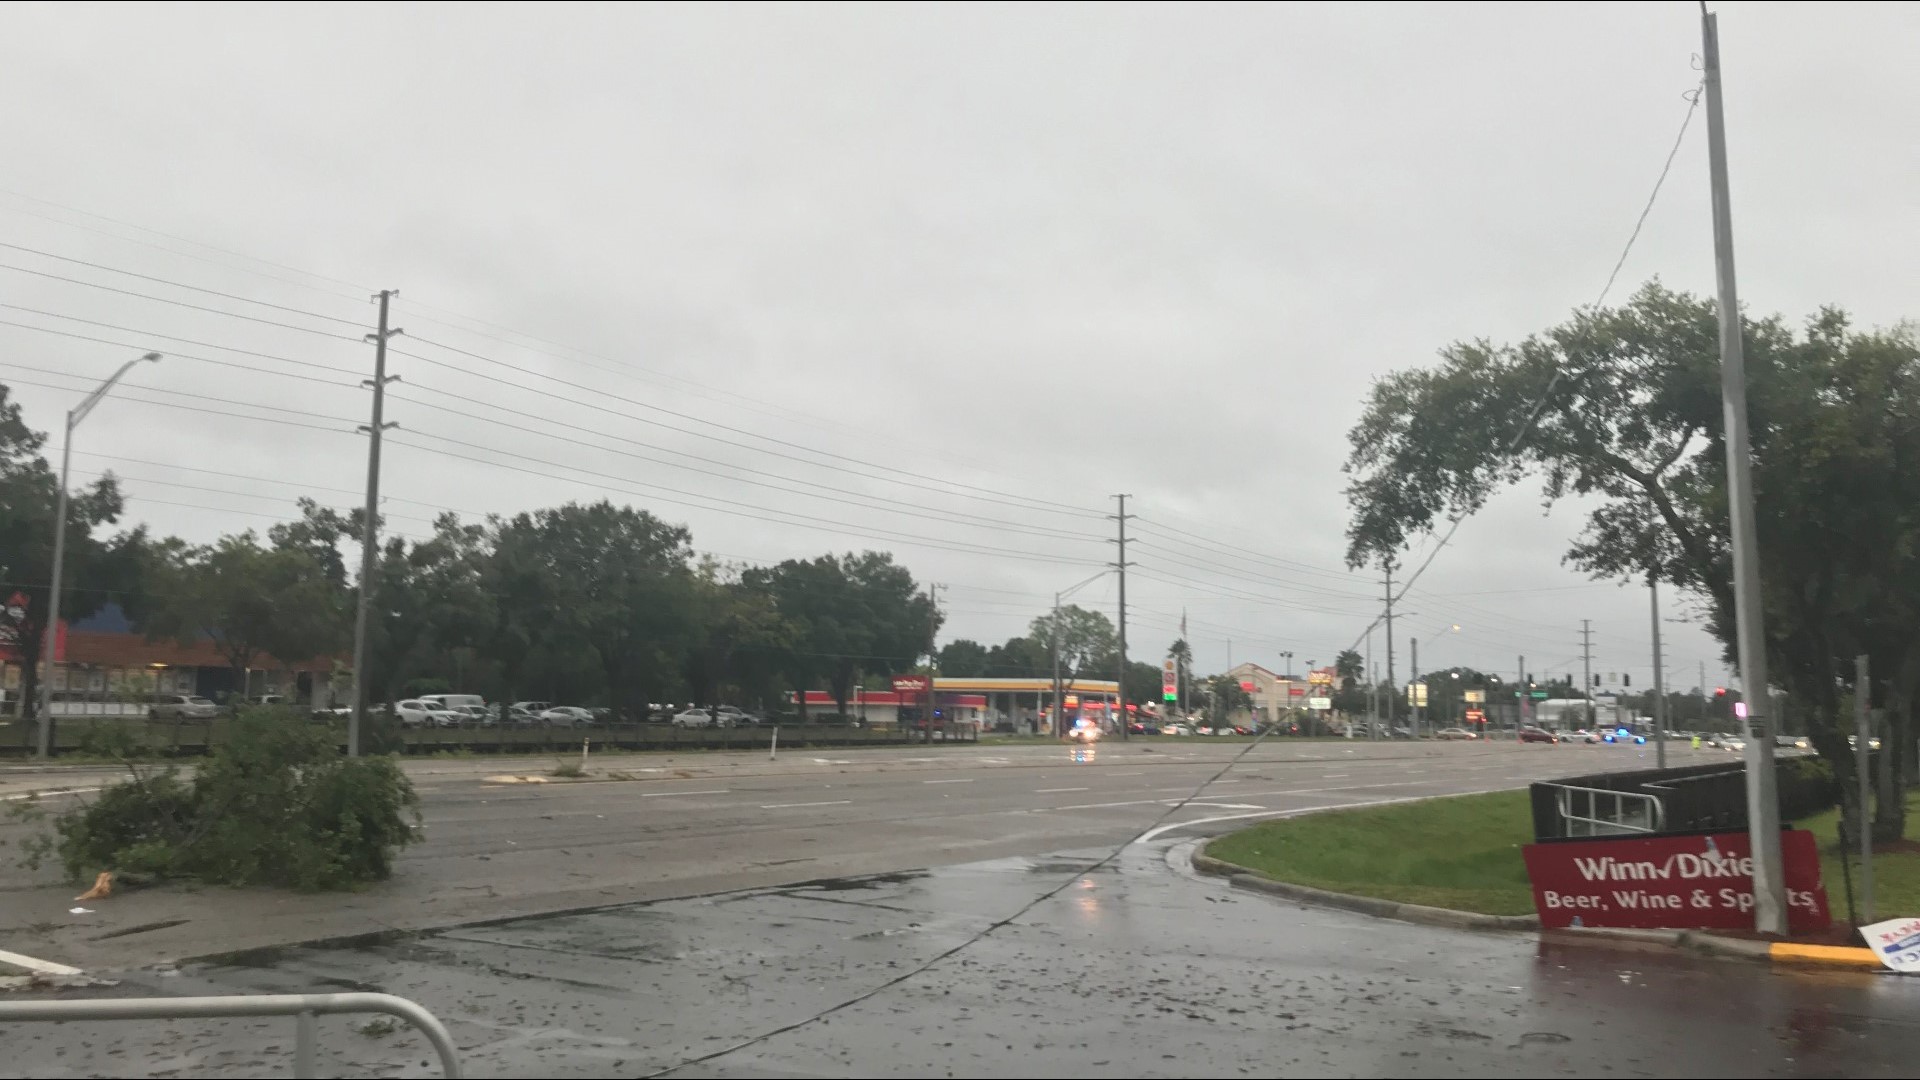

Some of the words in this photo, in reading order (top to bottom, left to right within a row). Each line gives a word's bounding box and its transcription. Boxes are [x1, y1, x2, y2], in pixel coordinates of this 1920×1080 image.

[1544, 890, 1608, 911] Beer,
[1612, 889, 1682, 909] Wine
[1690, 889, 1712, 908] &
[1719, 887, 1814, 912] Spts
